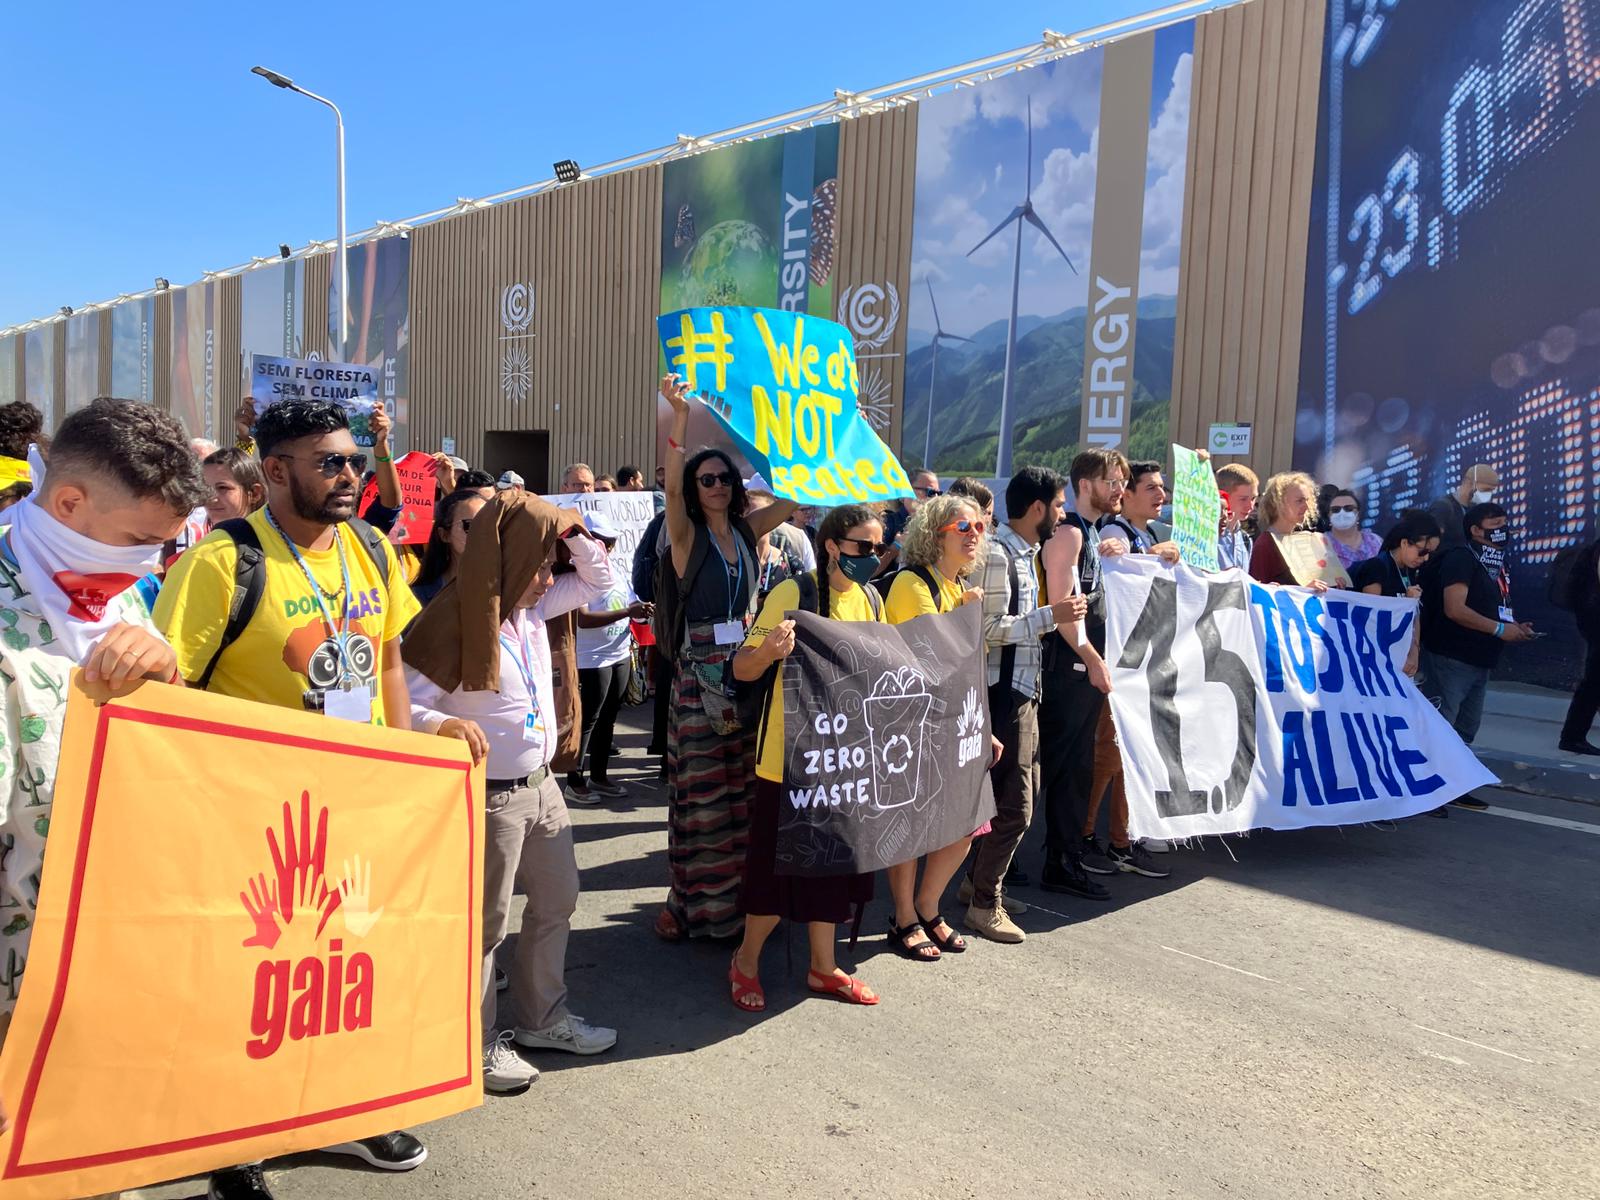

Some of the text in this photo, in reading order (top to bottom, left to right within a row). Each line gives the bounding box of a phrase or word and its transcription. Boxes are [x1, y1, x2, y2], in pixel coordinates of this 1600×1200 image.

[780, 192, 809, 312] RSITY
[753, 311, 821, 389] We
[205, 329, 213, 440] APTATION
[258, 363, 372, 383] SEM FLORESTA
[272, 382, 359, 399] SEM CLIMA
[752, 384, 842, 460] NOT
[411, 471, 424, 480] DE
[341, 588, 383, 619] GAS
[814, 712, 848, 735] GO
[803, 746, 865, 775] ZERO
[958, 731, 984, 768] gaia
[1281, 710, 1446, 807] ALIVE
[789, 777, 870, 810] WASTE
[246, 938, 374, 1060] gaia
